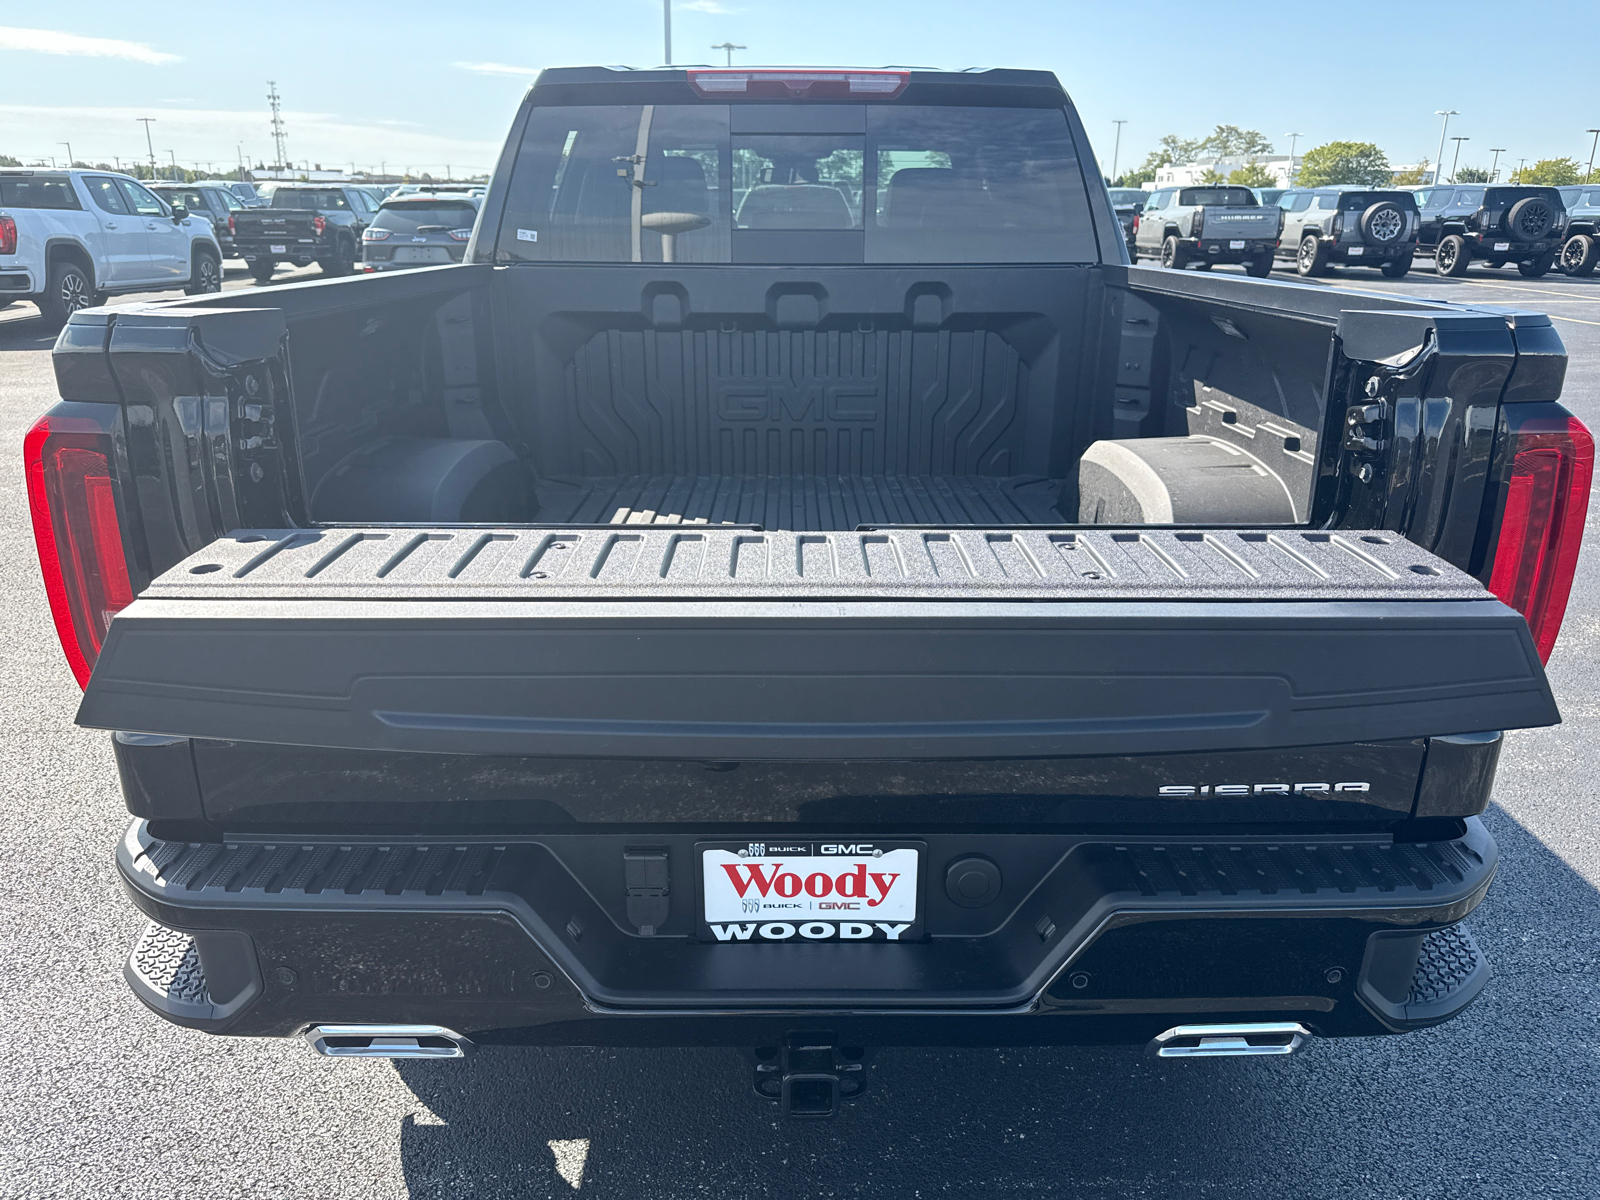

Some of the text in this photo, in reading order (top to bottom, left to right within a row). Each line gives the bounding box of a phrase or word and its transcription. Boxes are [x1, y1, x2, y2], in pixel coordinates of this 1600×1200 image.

[717, 385, 878, 423] GMC
[1157, 781, 1371, 797] SIERRA
[820, 844, 874, 854] GMC
[720, 863, 901, 907] Woody
[818, 902, 861, 910] GMC
[709, 921, 912, 941] WOODY
